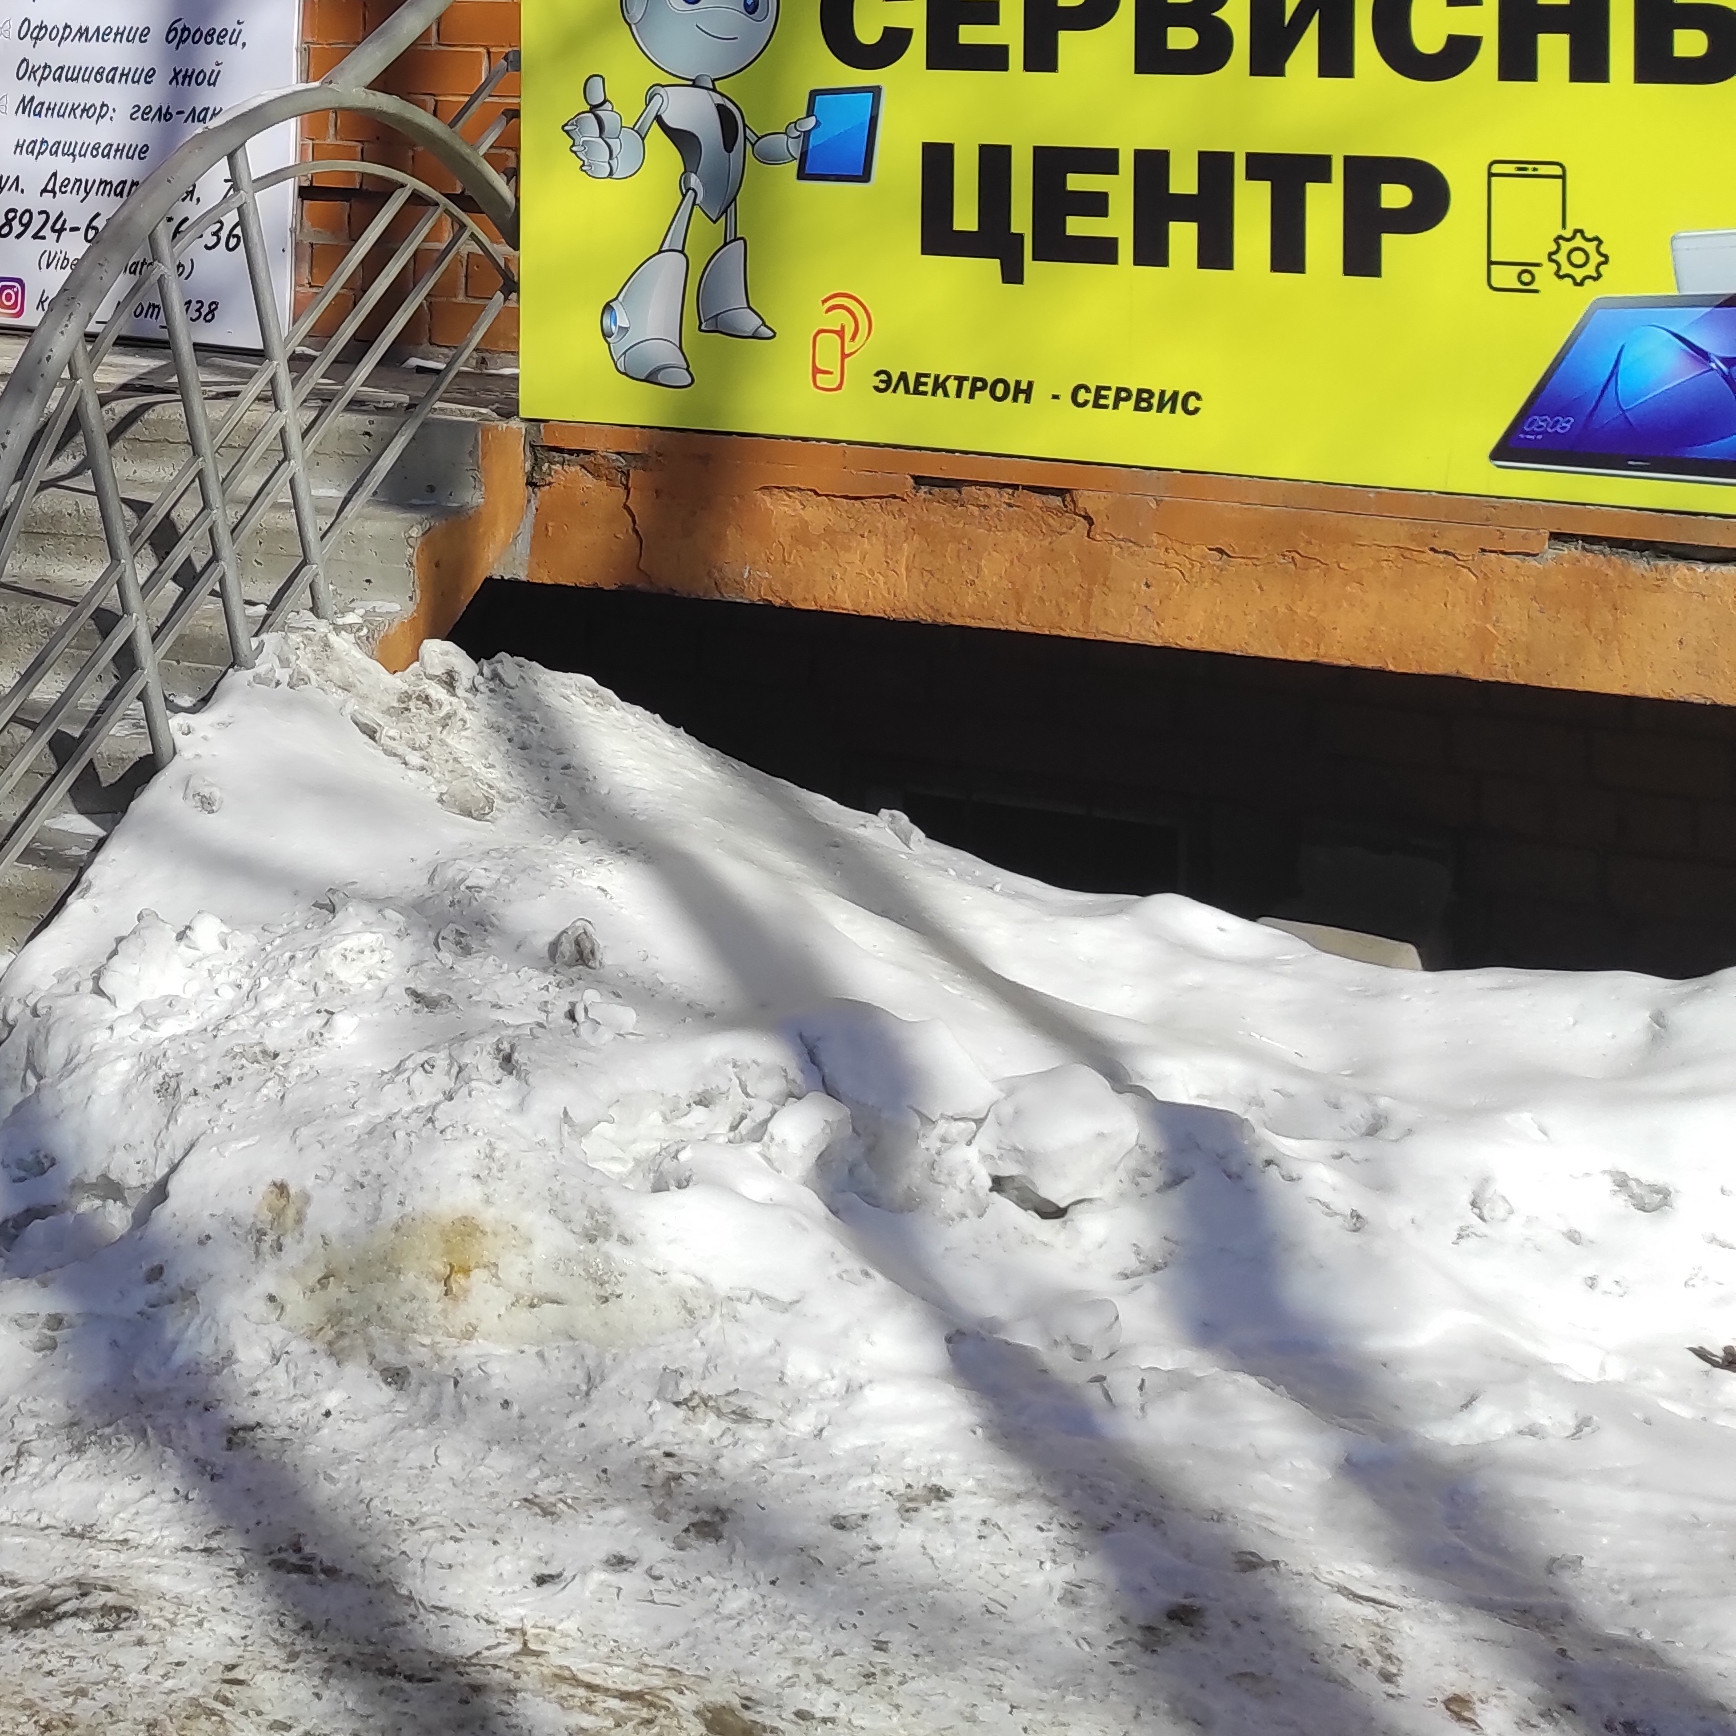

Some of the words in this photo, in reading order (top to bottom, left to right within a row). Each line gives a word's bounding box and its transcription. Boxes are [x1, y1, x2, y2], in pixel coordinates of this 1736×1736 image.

[17, 17, 152, 48] Оформление
[164, 17, 248, 50] бровей,
[15, 57, 157, 85] Окрашивание
[168, 60, 223, 88] хной
[14, 94, 117, 125] Маникюр:
[13, 135, 150, 164] наращивание
[919, 141, 1451, 285] ЦЕНТР
[872, 369, 1035, 404] ЭЛЕКТРОН
[1070, 383, 1203, 416] СЕРВИС
